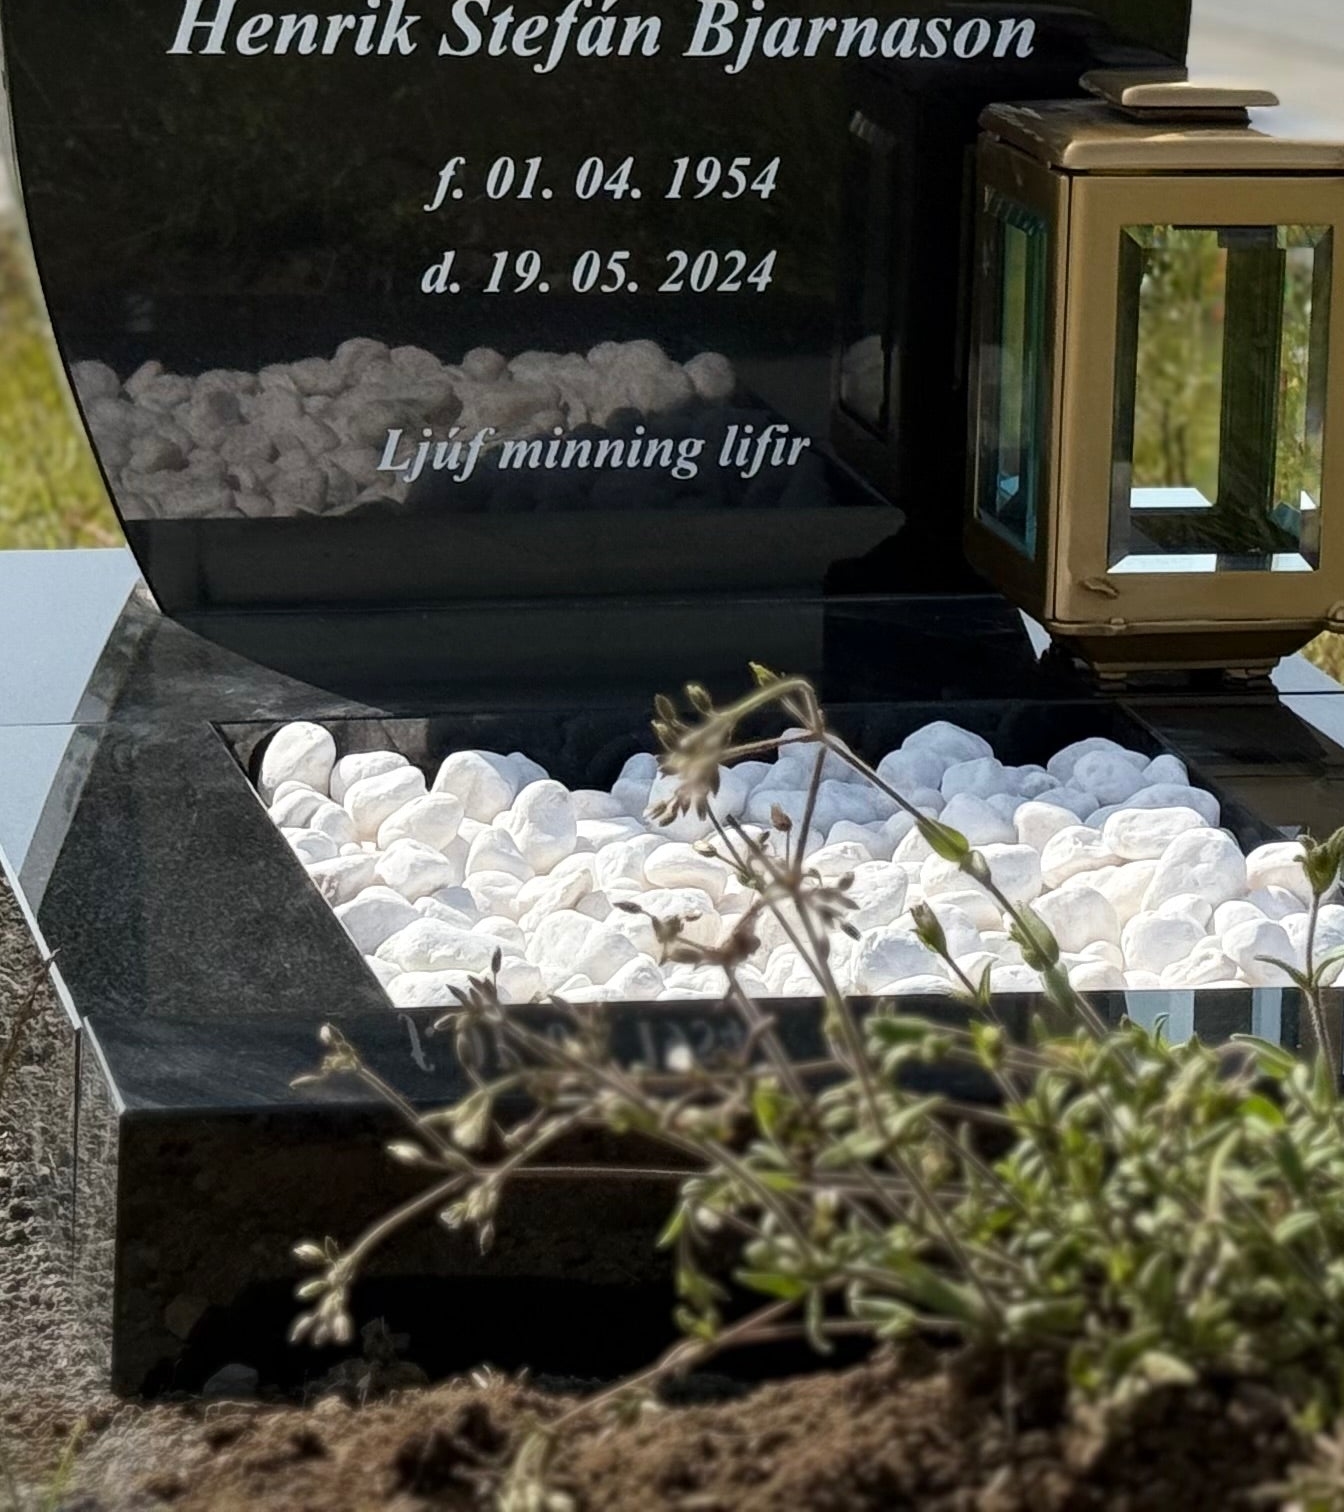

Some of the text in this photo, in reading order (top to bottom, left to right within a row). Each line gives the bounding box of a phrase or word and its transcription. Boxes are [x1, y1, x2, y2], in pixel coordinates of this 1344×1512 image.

[423, 156, 781, 212] f. 01. 04. 1954
[421, 249, 777, 294] d. 19. 05. 2024
[377, 423, 812, 483] Ljúf minning lifir
